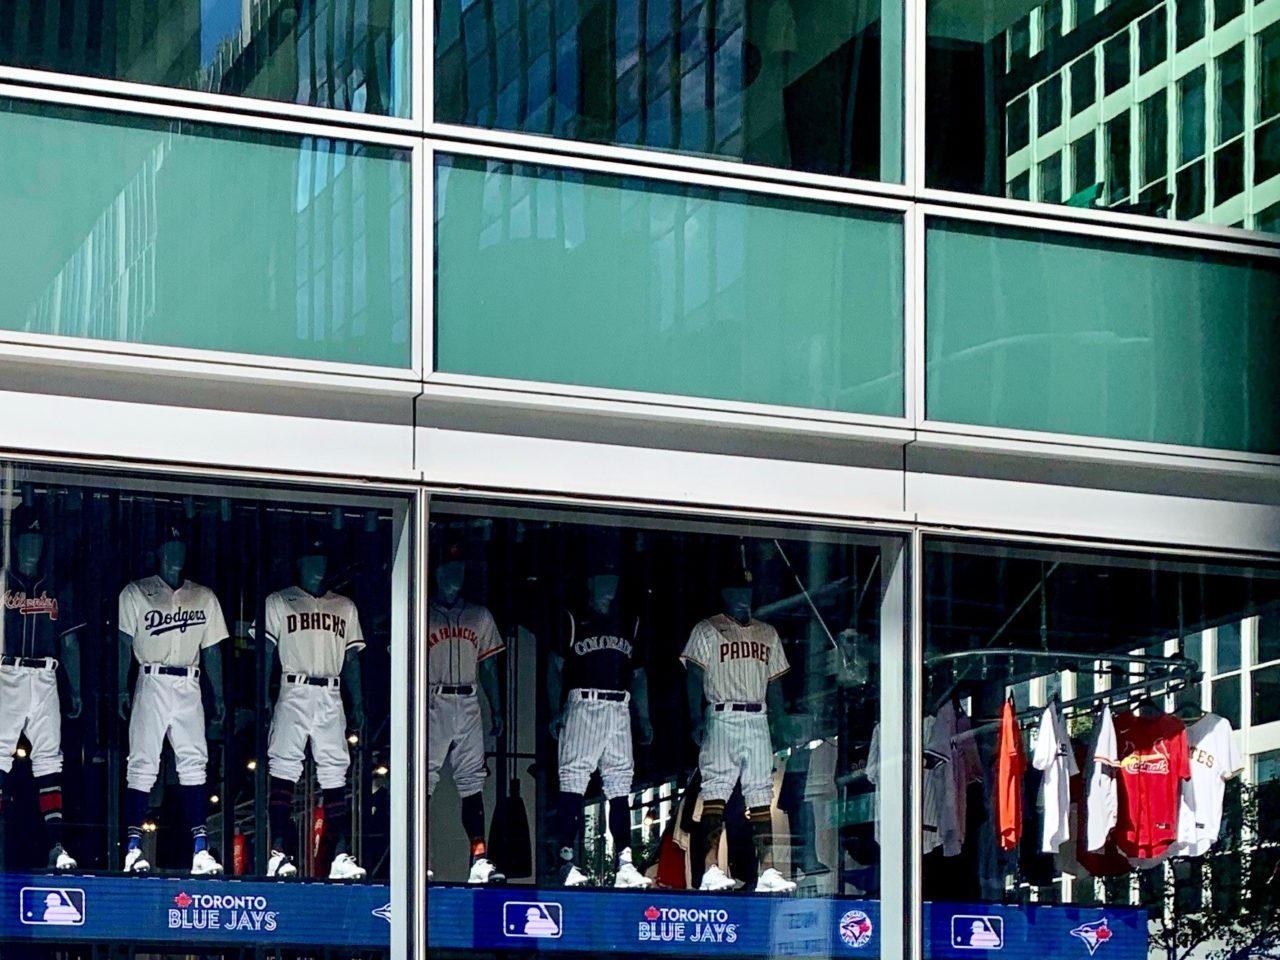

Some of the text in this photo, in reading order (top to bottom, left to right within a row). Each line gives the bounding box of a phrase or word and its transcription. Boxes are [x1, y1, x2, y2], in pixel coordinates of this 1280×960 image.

[144, 606, 206, 634] Dodgers
[720, 641, 770, 666] PADRES
[192, 894, 267, 910] TORONTO
[168, 908, 277, 931] BLUE JAYS
[660, 908, 728, 922] TORONTO
[638, 921, 738, 943] BLUE JAYS
